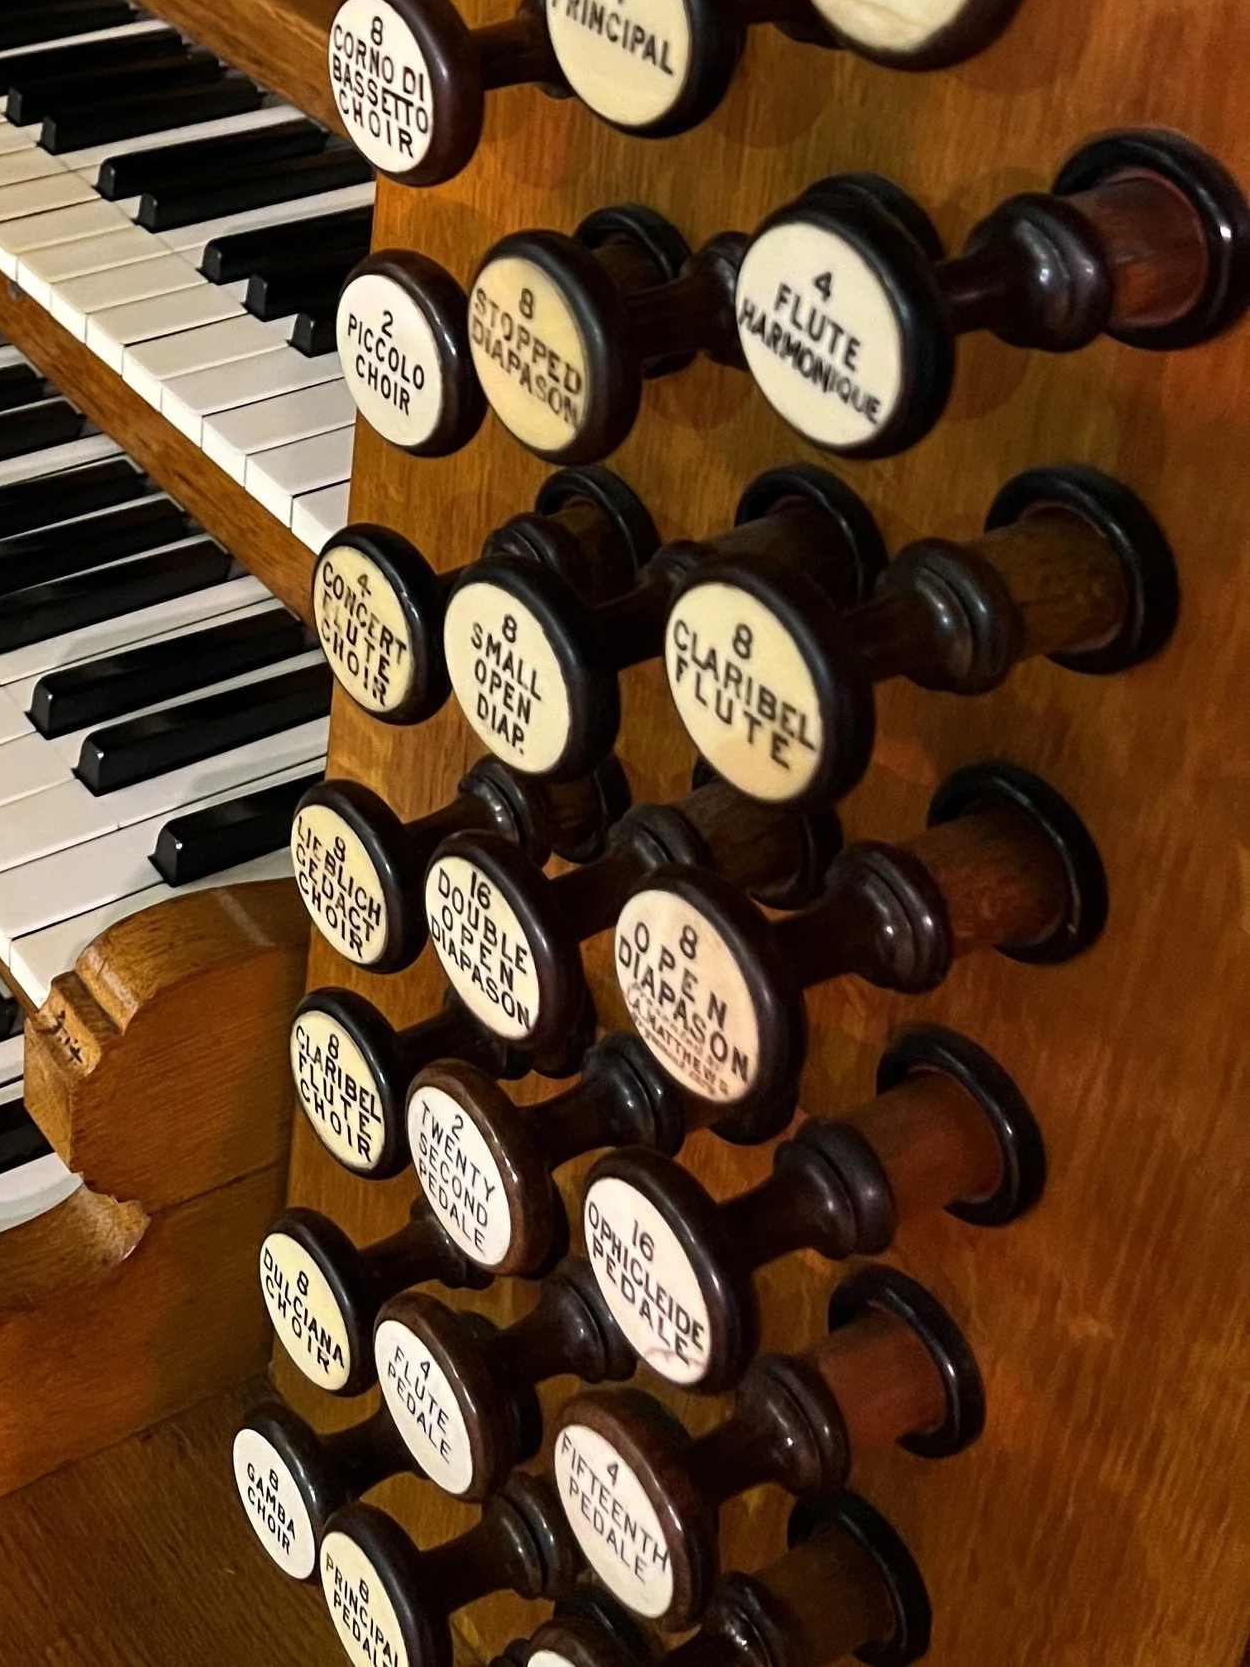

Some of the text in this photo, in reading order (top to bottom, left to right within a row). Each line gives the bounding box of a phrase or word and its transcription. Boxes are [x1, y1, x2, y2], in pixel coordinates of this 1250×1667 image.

[333, 24, 425, 102] CORNO DI
[370, 15, 384, 47] 8
[332, 53, 429, 134] BASSETTO
[338, 89, 414, 158] CHOIR
[381, 309, 394, 339] 2
[518, 287, 535, 320] 8
[773, 281, 862, 372] FLUTE
[812, 270, 833, 303] 4
[347, 313, 425, 390] PICCOLO
[355, 354, 411, 416] CHOIR
[471, 314, 580, 429] DIAPASON
[474, 287, 582, 395] STOPPED
[737, 296, 881, 426] HARMONIQUE
[322, 561, 408, 665] CONCERT
[356, 573, 372, 598] 4
[502, 613, 518, 644] 8
[321, 617, 386, 706] CHOIR
[470, 621, 542, 702] SMALL
[672, 618, 816, 752] CLARIBEL
[731, 623, 753, 660] 8
[474, 658, 532, 725] OPEN
[476, 692, 525, 755] DIAP.
[675, 653, 791, 770] FLUTE
[295, 842, 374, 942] GEDACT
[297, 815, 381, 926] LIEBLICH
[334, 836, 346, 864] 8
[469, 870, 492, 911] 16
[298, 871, 363, 959] CHOIR
[438, 867, 528, 976] DOUBLE
[442, 905, 514, 992] OPEN
[679, 924, 698, 961] 8
[430, 913, 530, 1031] DIAPASON
[618, 934, 749, 1083] DIAPASON
[634, 921, 727, 1030] OPEN
[296, 1024, 382, 1124] CLARIBEL
[327, 1033, 340, 1061] 8
[298, 1051, 372, 1141] FLUTE
[300, 1077, 371, 1163] CHOIR
[451, 1114, 465, 1140] 2
[419, 1132, 488, 1228] SECOND
[421, 1100, 496, 1203] TWENTY
[418, 1158, 486, 1256] PEDALE
[631, 1219, 655, 1263] 16
[263, 1247, 345, 1369] DULCIANA
[297, 1270, 310, 1297] 8
[588, 1200, 705, 1352] OPHICLEIDE
[592, 1232, 690, 1366] PEDALE
[265, 1275, 330, 1375] CHOIR
[387, 1360, 452, 1465] PEDALE
[394, 1344, 450, 1435] FLUTE
[246, 1462, 296, 1541] GAMBA
[247, 1485, 291, 1556] CHOIR
[560, 1432, 670, 1574] FIFTEENTH
[568, 1475, 648, 1585] PEDALE
[333, 1589, 388, 1667] PEDAL
